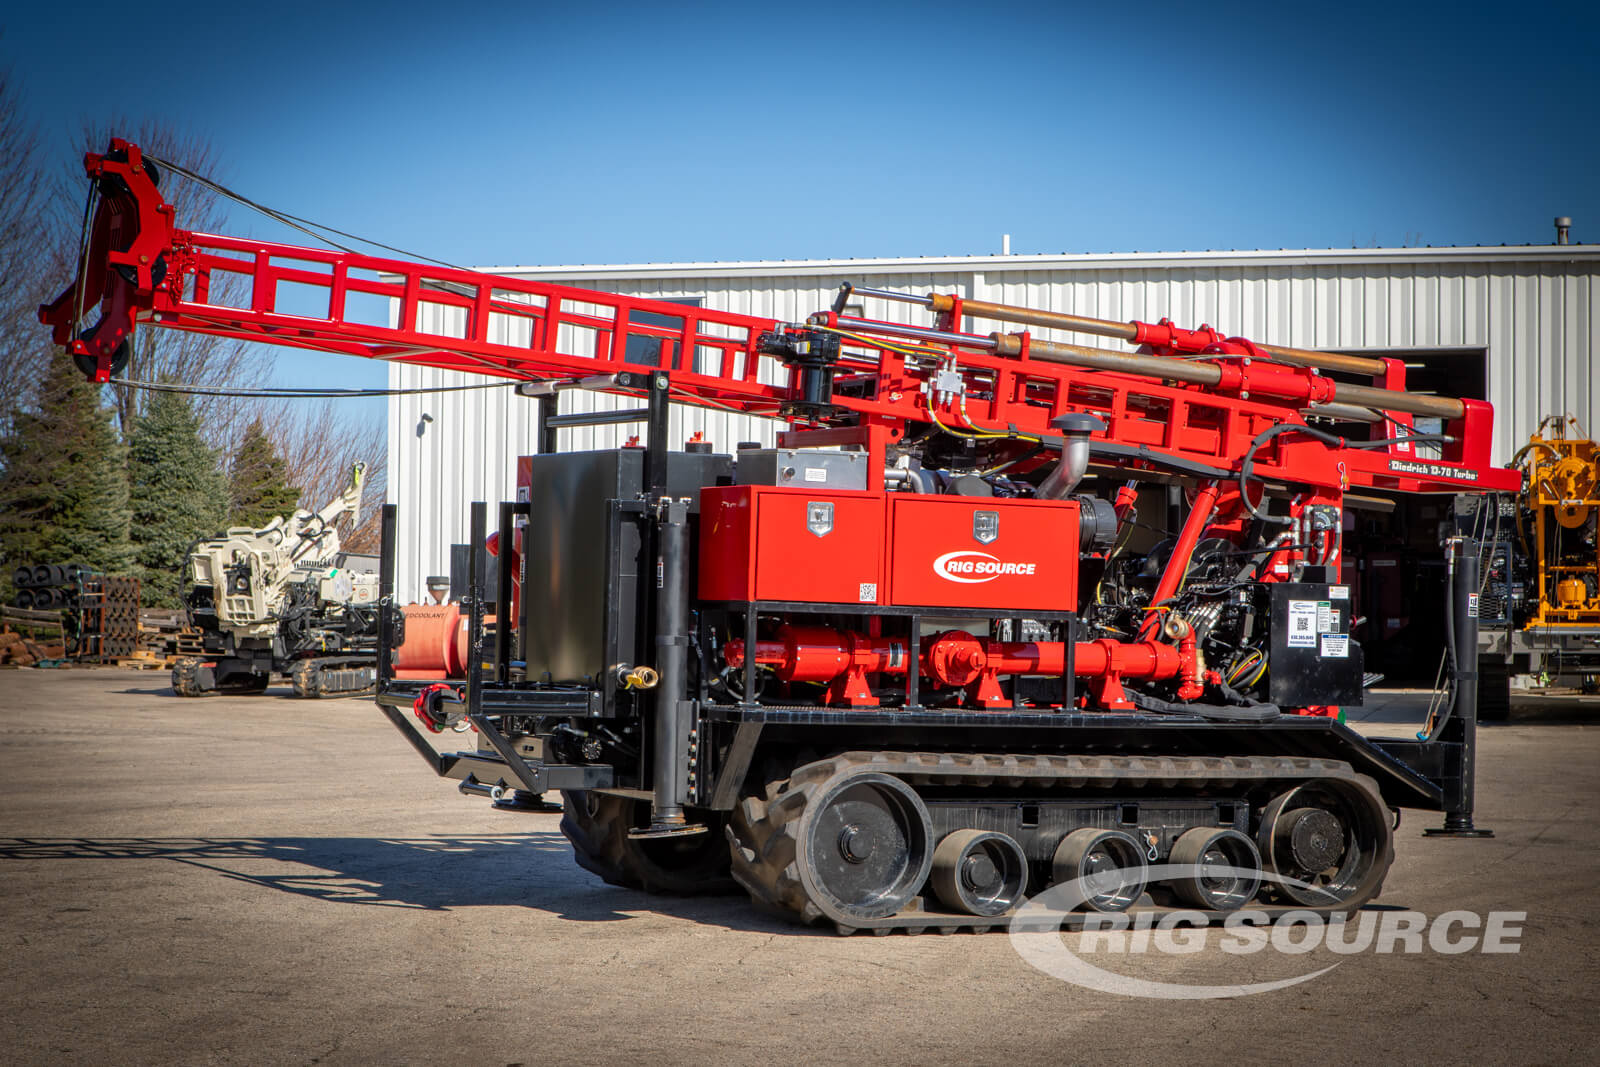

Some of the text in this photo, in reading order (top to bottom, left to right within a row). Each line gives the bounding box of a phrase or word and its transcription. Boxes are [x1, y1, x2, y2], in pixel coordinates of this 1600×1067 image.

[1391, 460, 1428, 474] Diedrich
[1453, 468, 1476, 480] Turbo
[947, 561, 1036, 575] RIG SOURCE
